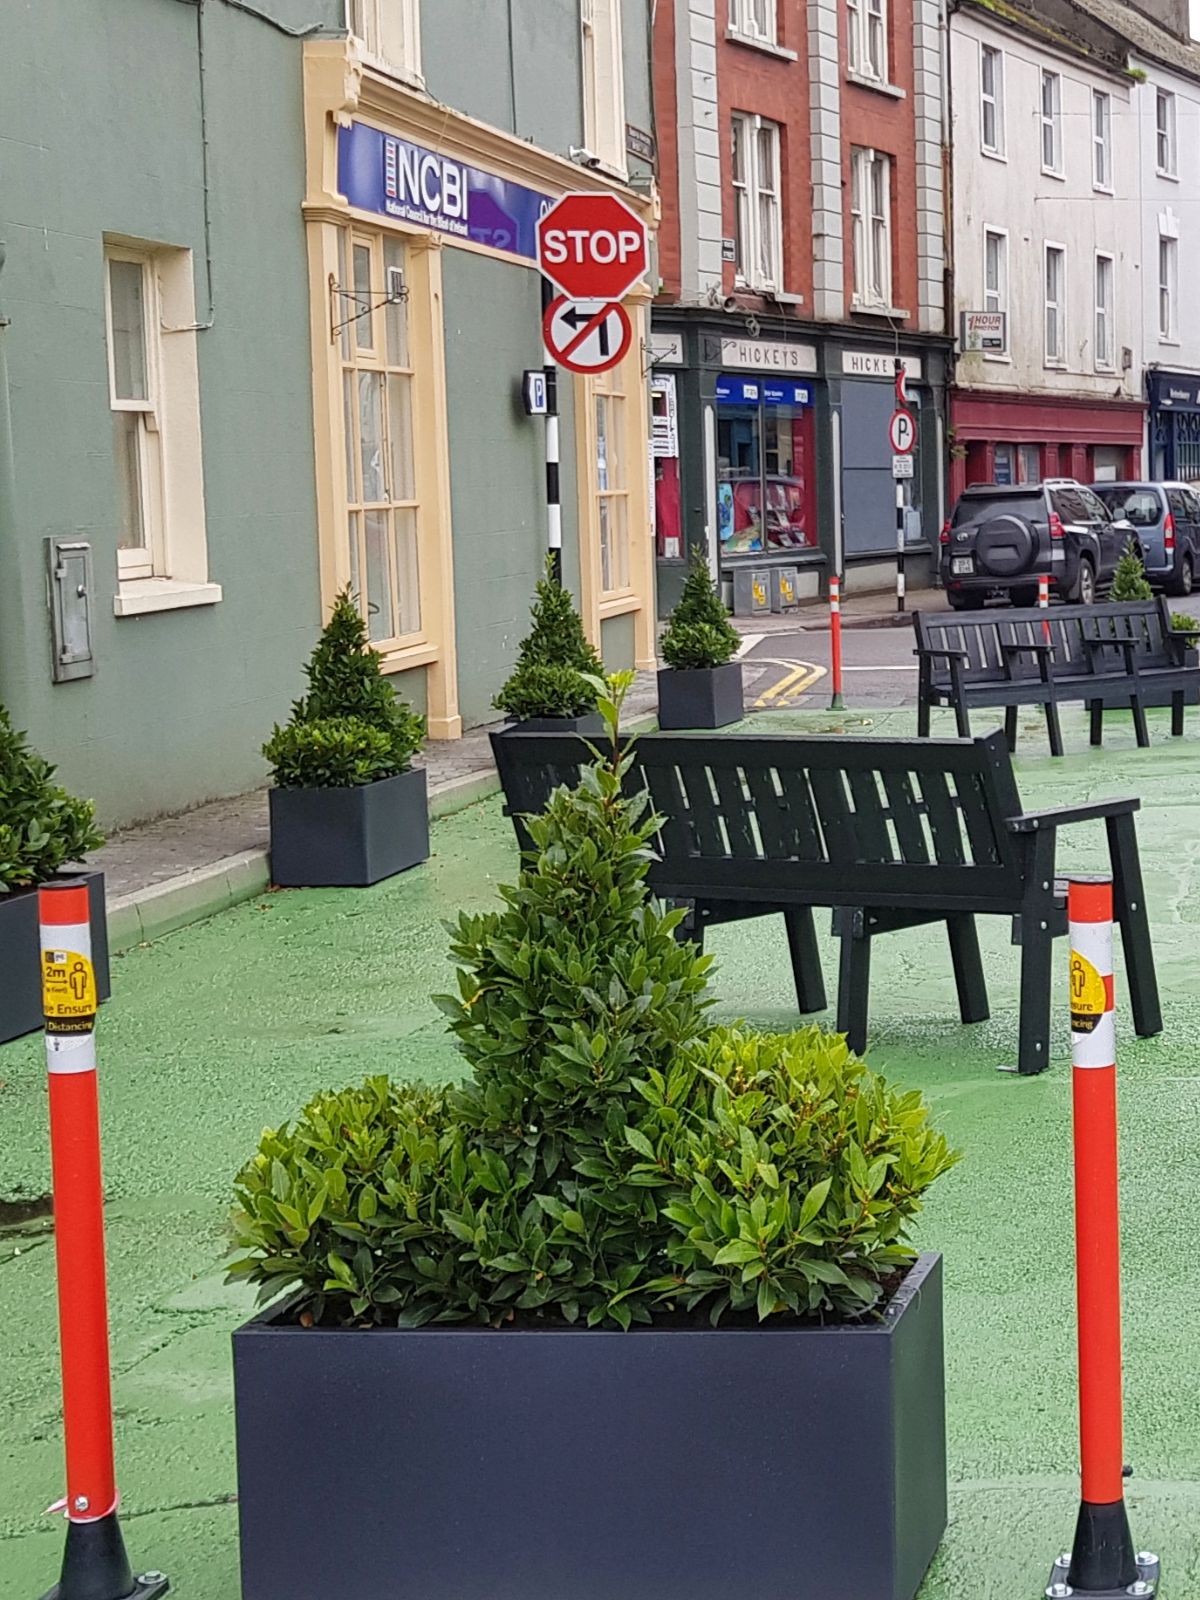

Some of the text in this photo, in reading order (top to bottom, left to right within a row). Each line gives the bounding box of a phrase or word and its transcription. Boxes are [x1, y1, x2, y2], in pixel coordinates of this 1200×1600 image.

[398, 144, 468, 221] NCBI
[544, 229, 641, 264] STOP
[976, 315, 1002, 325] HOUR
[46, 966, 66, 978] 2m
